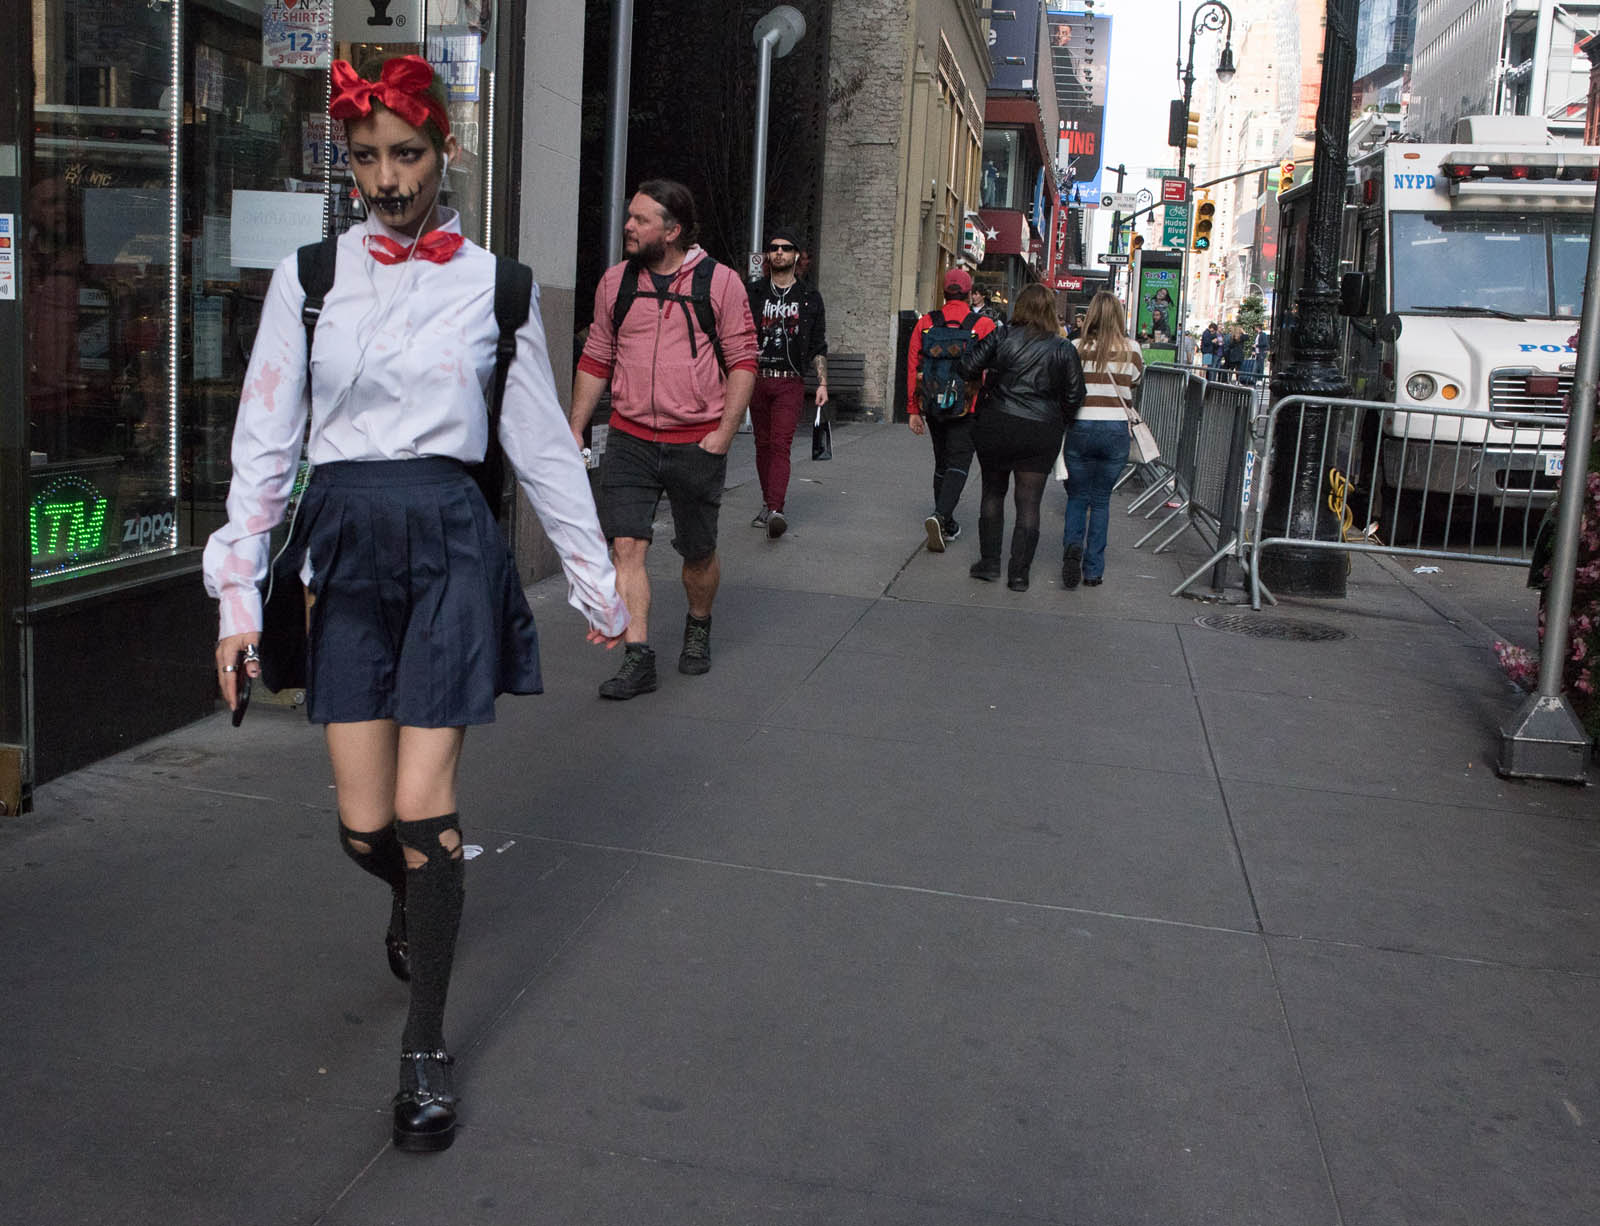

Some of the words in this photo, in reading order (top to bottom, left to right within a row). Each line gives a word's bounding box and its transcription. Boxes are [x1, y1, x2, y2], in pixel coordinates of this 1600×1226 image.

[272, 12, 325, 22] T-SHIRTS
[1393, 174, 1436, 189] NYPD
[1165, 219, 1187, 227] Hudso
[1057, 280, 1080, 290] Arby's
[763, 299, 799, 319] lipkno
[1518, 344, 1577, 353] POL
[1244, 452, 1254, 502] NYPD
[123, 512, 173, 545] zippo
